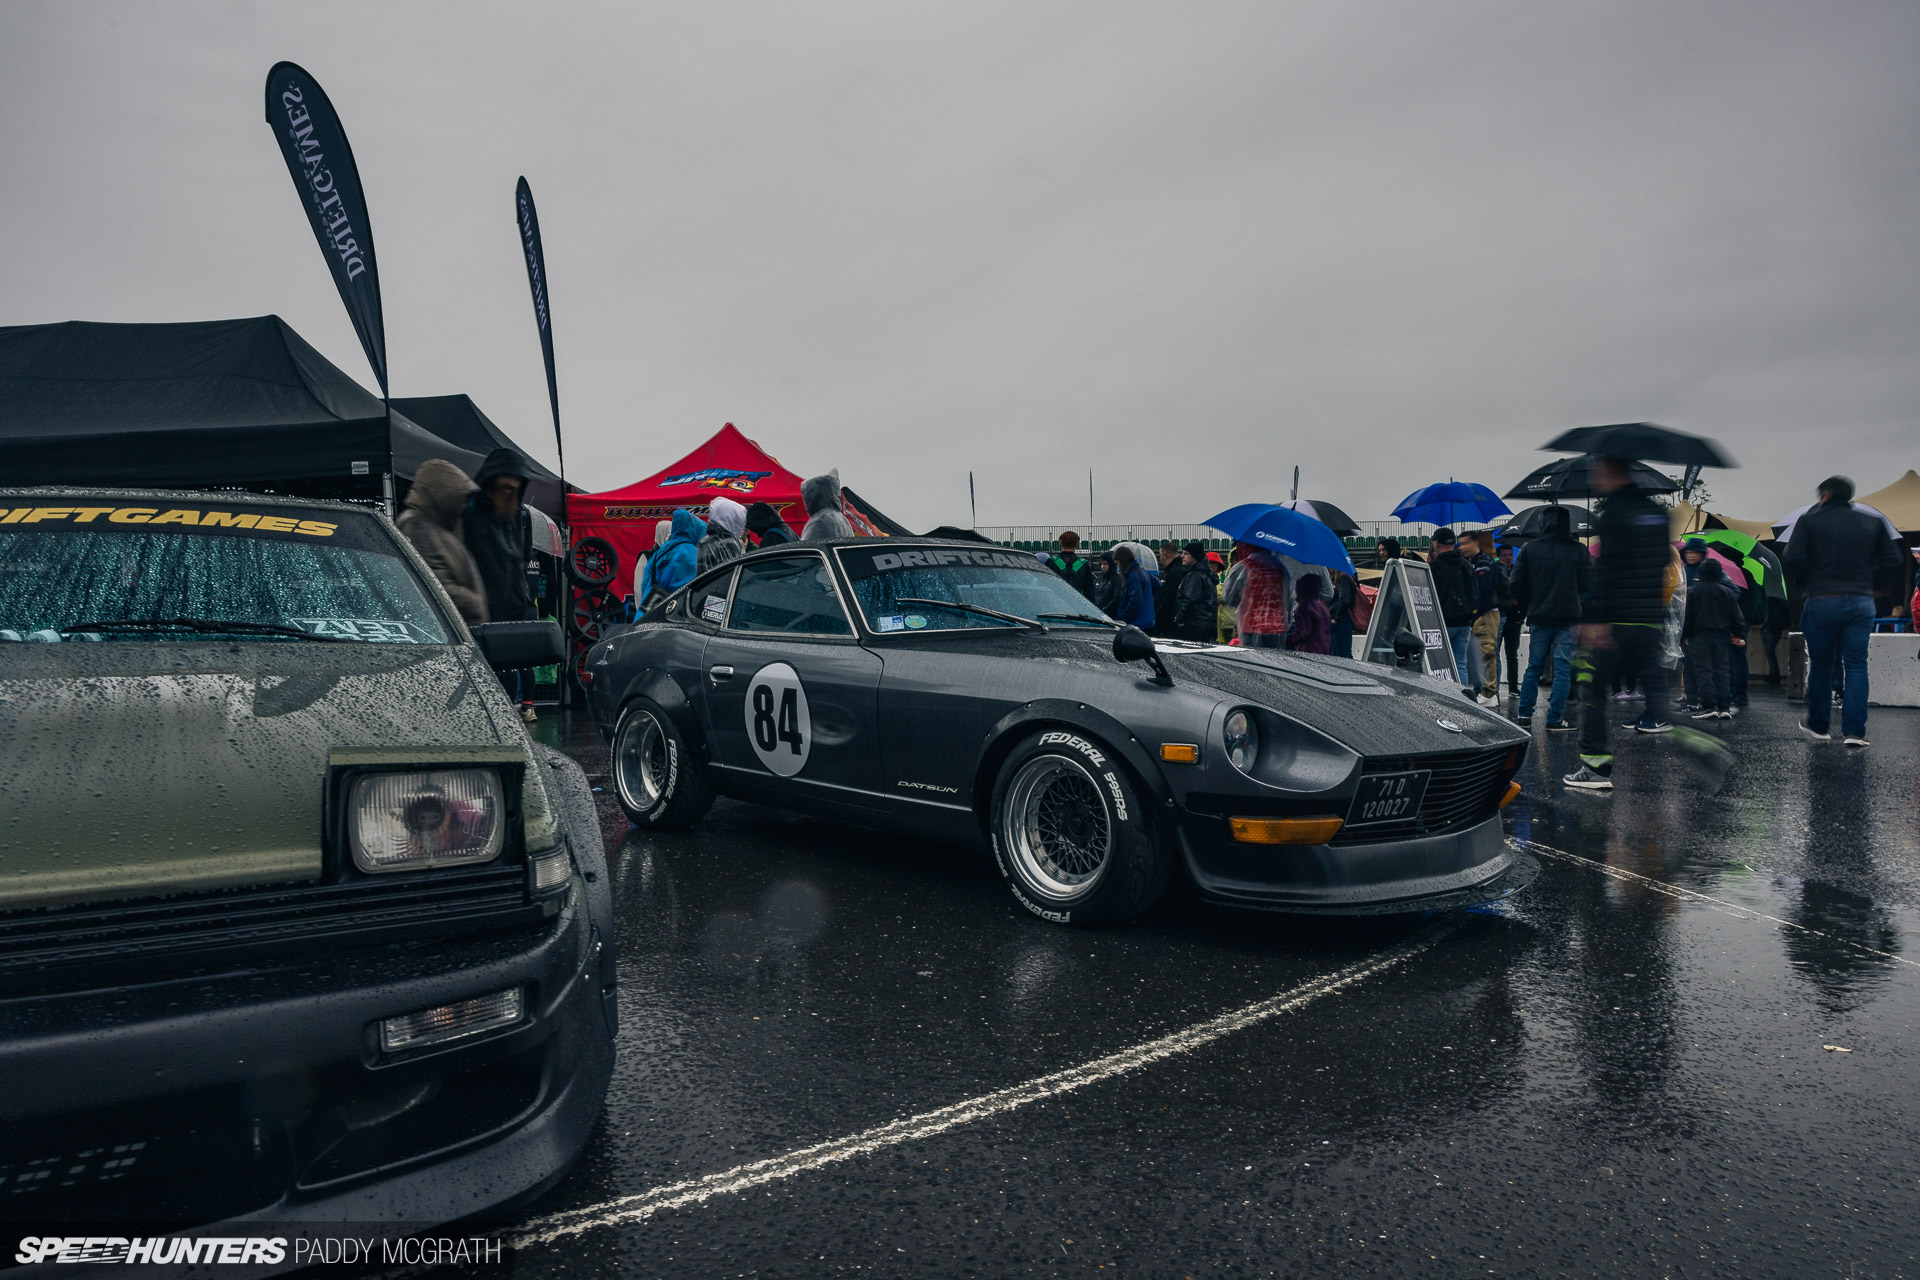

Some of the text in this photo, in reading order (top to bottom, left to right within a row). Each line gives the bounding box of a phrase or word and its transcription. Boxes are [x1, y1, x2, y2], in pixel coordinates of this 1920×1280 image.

[657, 468, 774, 488] DRIFT
[1685, 464, 1699, 490] DRIFTGAM
[0, 507, 338, 537] IFTGAMES
[302, 620, 410, 634] ZV37
[753, 684, 803, 756] 84
[665, 738, 678, 799] FEDERAL
[1038, 732, 1128, 821] FEDERAL 595RS
[897, 781, 960, 794] DATSUN
[1378, 778, 1406, 797] 71 D
[1362, 797, 1410, 819] 120027
[1011, 883, 1070, 922] FEDERAL
